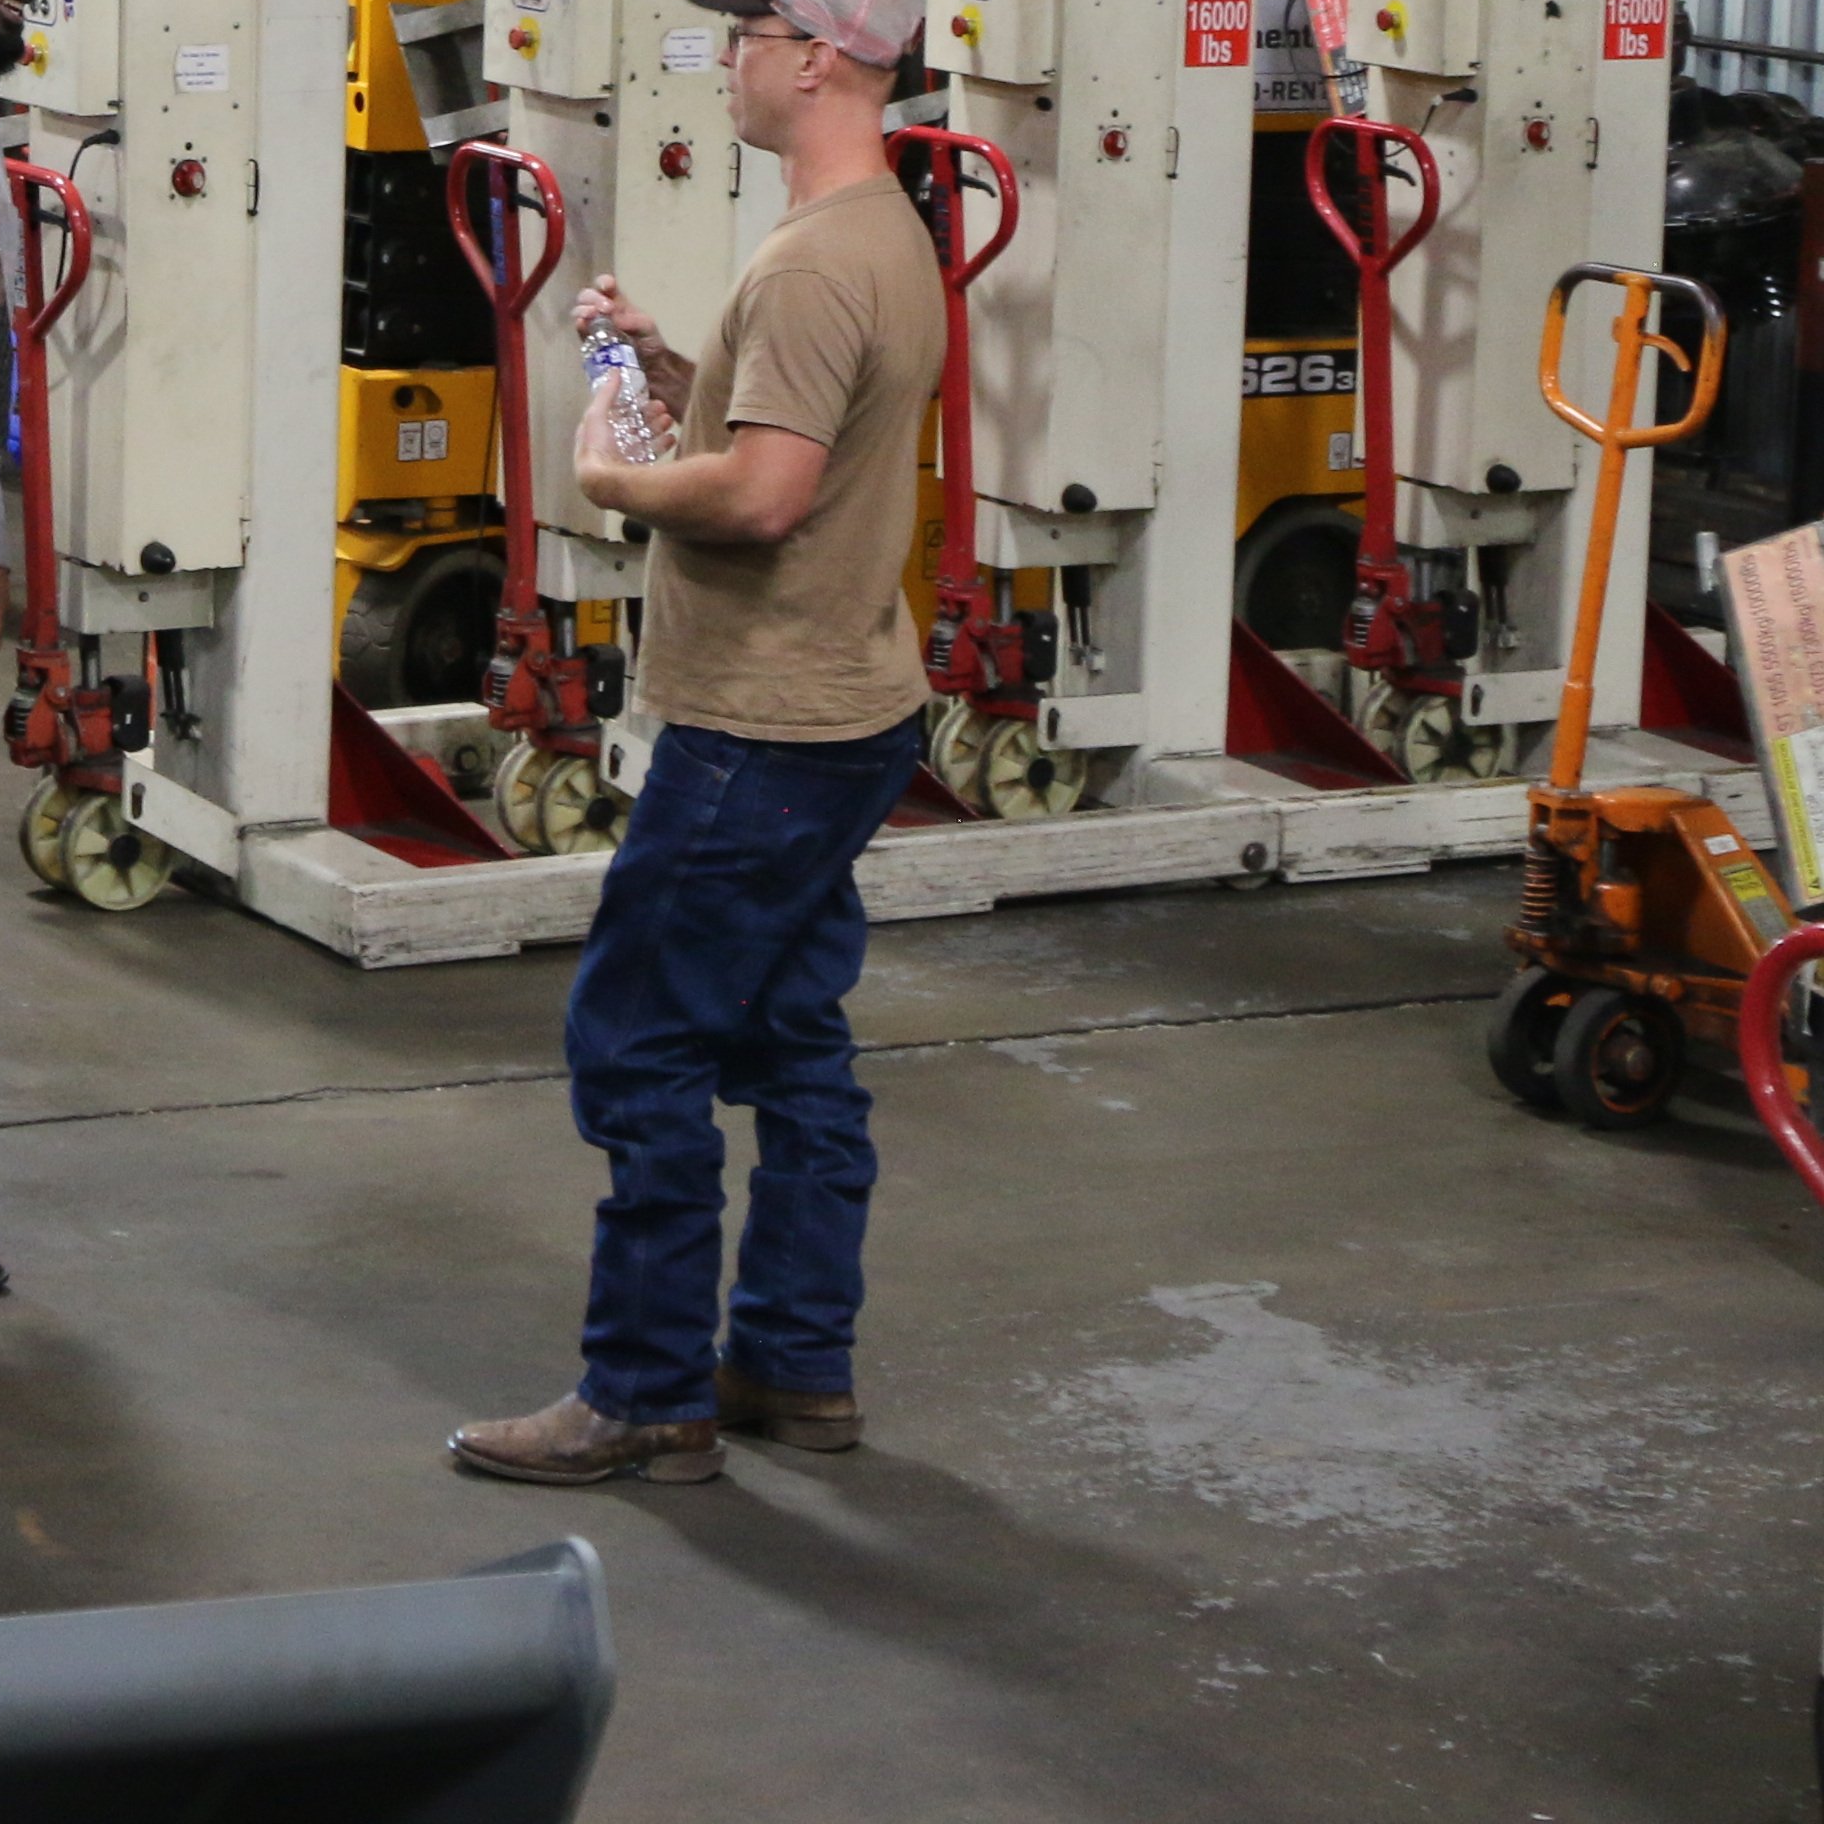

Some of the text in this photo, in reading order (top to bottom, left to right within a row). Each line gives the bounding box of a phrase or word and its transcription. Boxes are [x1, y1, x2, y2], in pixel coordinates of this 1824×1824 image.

[1188, 1, 1248, 30] 16000
[1200, 33, 1232, 63] lbs
[1255, 24, 1316, 49] ent
[1618, 28, 1649, 56] lbs
